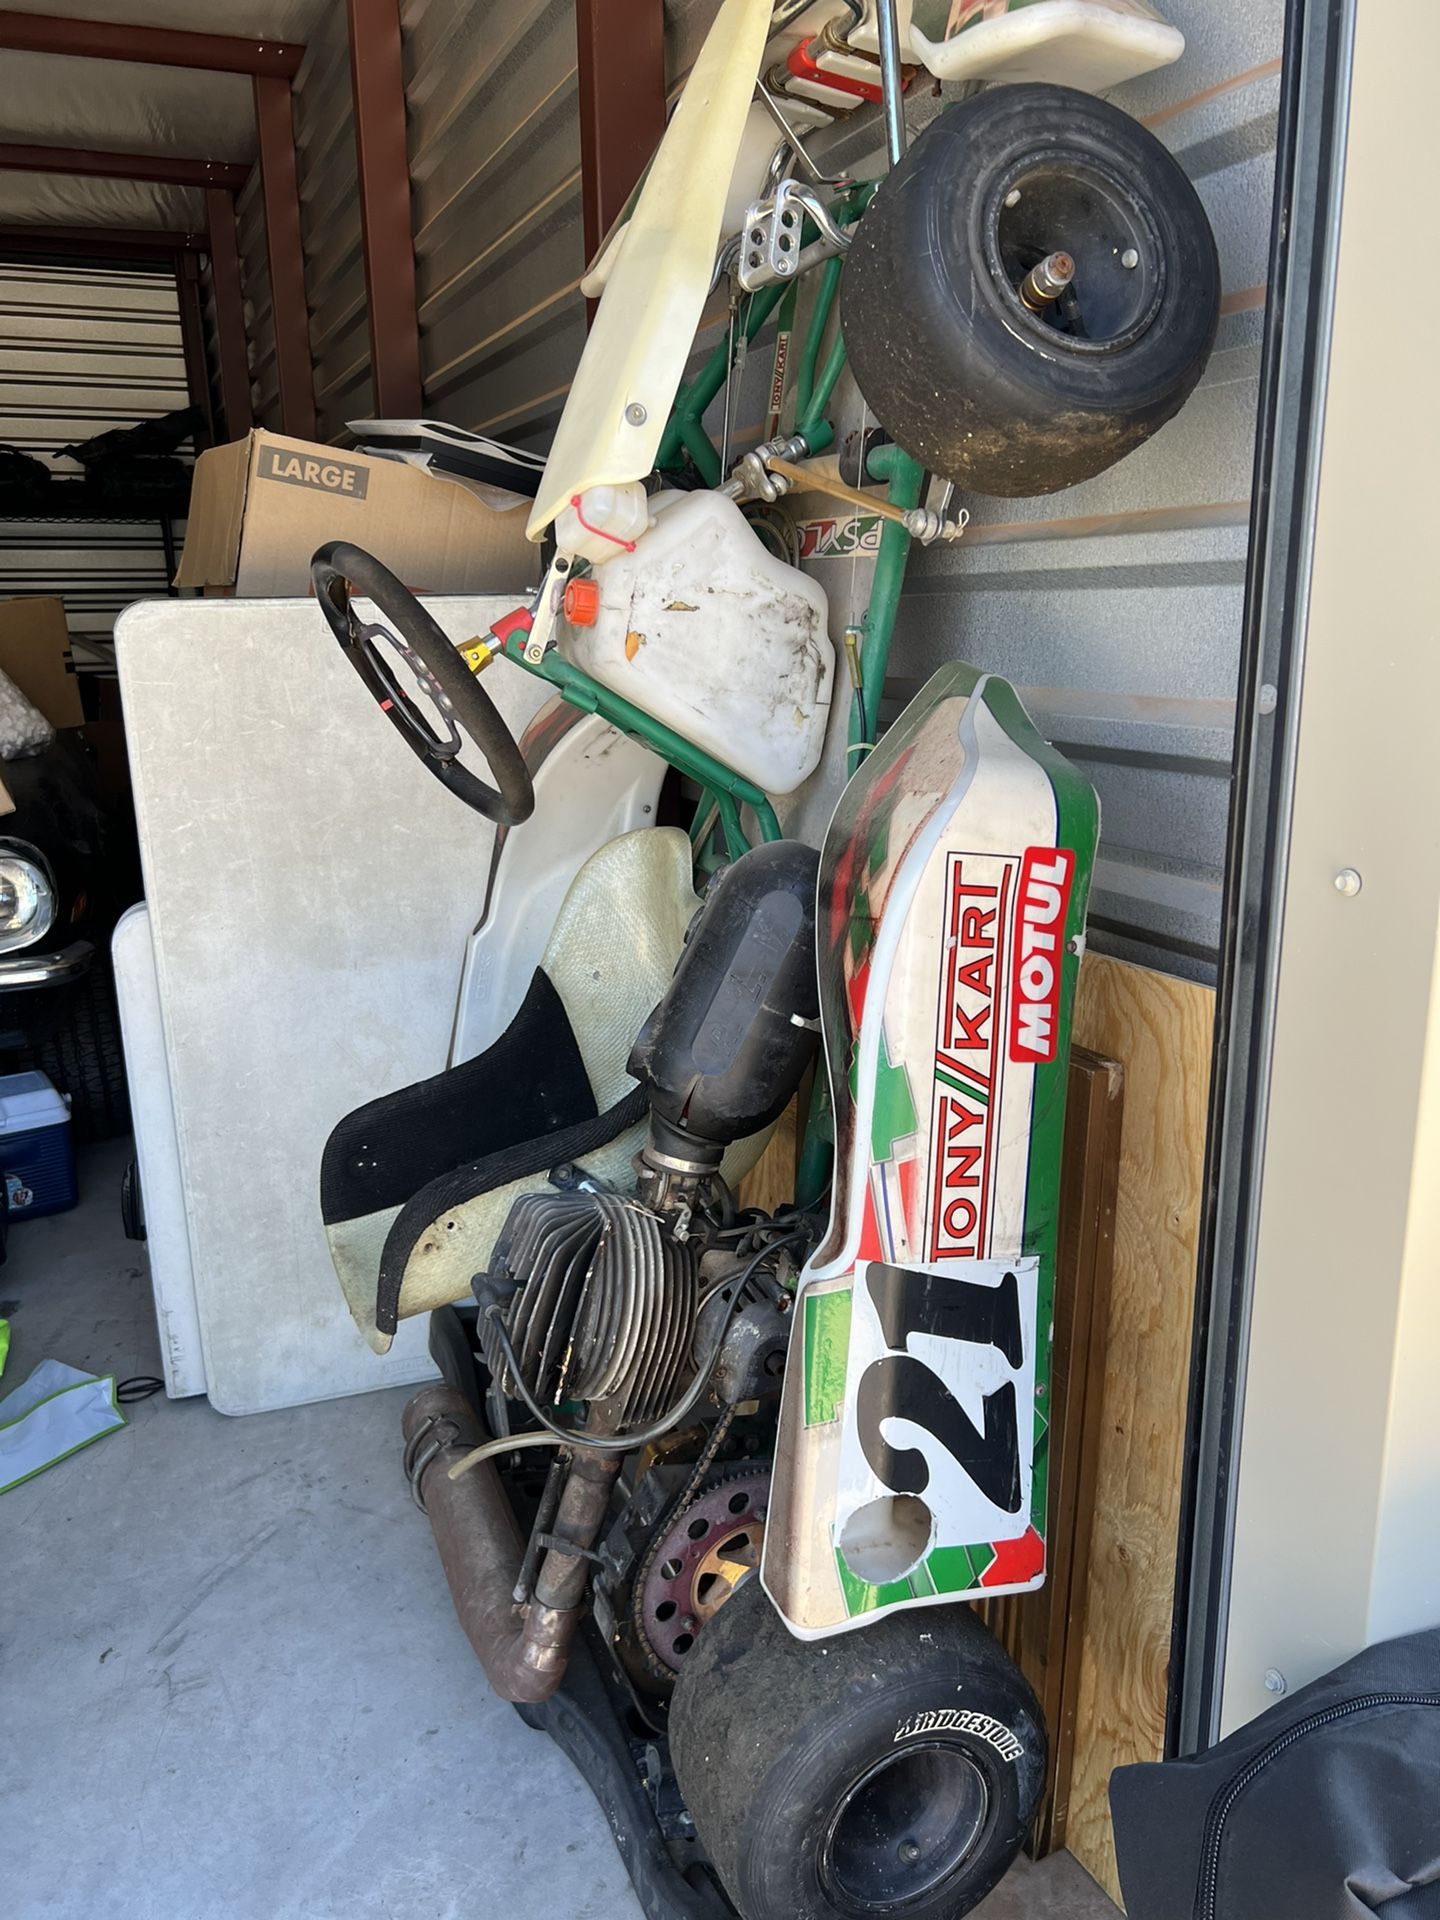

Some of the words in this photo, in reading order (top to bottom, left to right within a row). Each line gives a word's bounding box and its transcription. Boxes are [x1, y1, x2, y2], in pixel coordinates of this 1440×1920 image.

[271, 454, 356, 491] LARGE
[1018, 855, 1068, 1057] MOTUL
[856, 1262, 1024, 1514] 21
